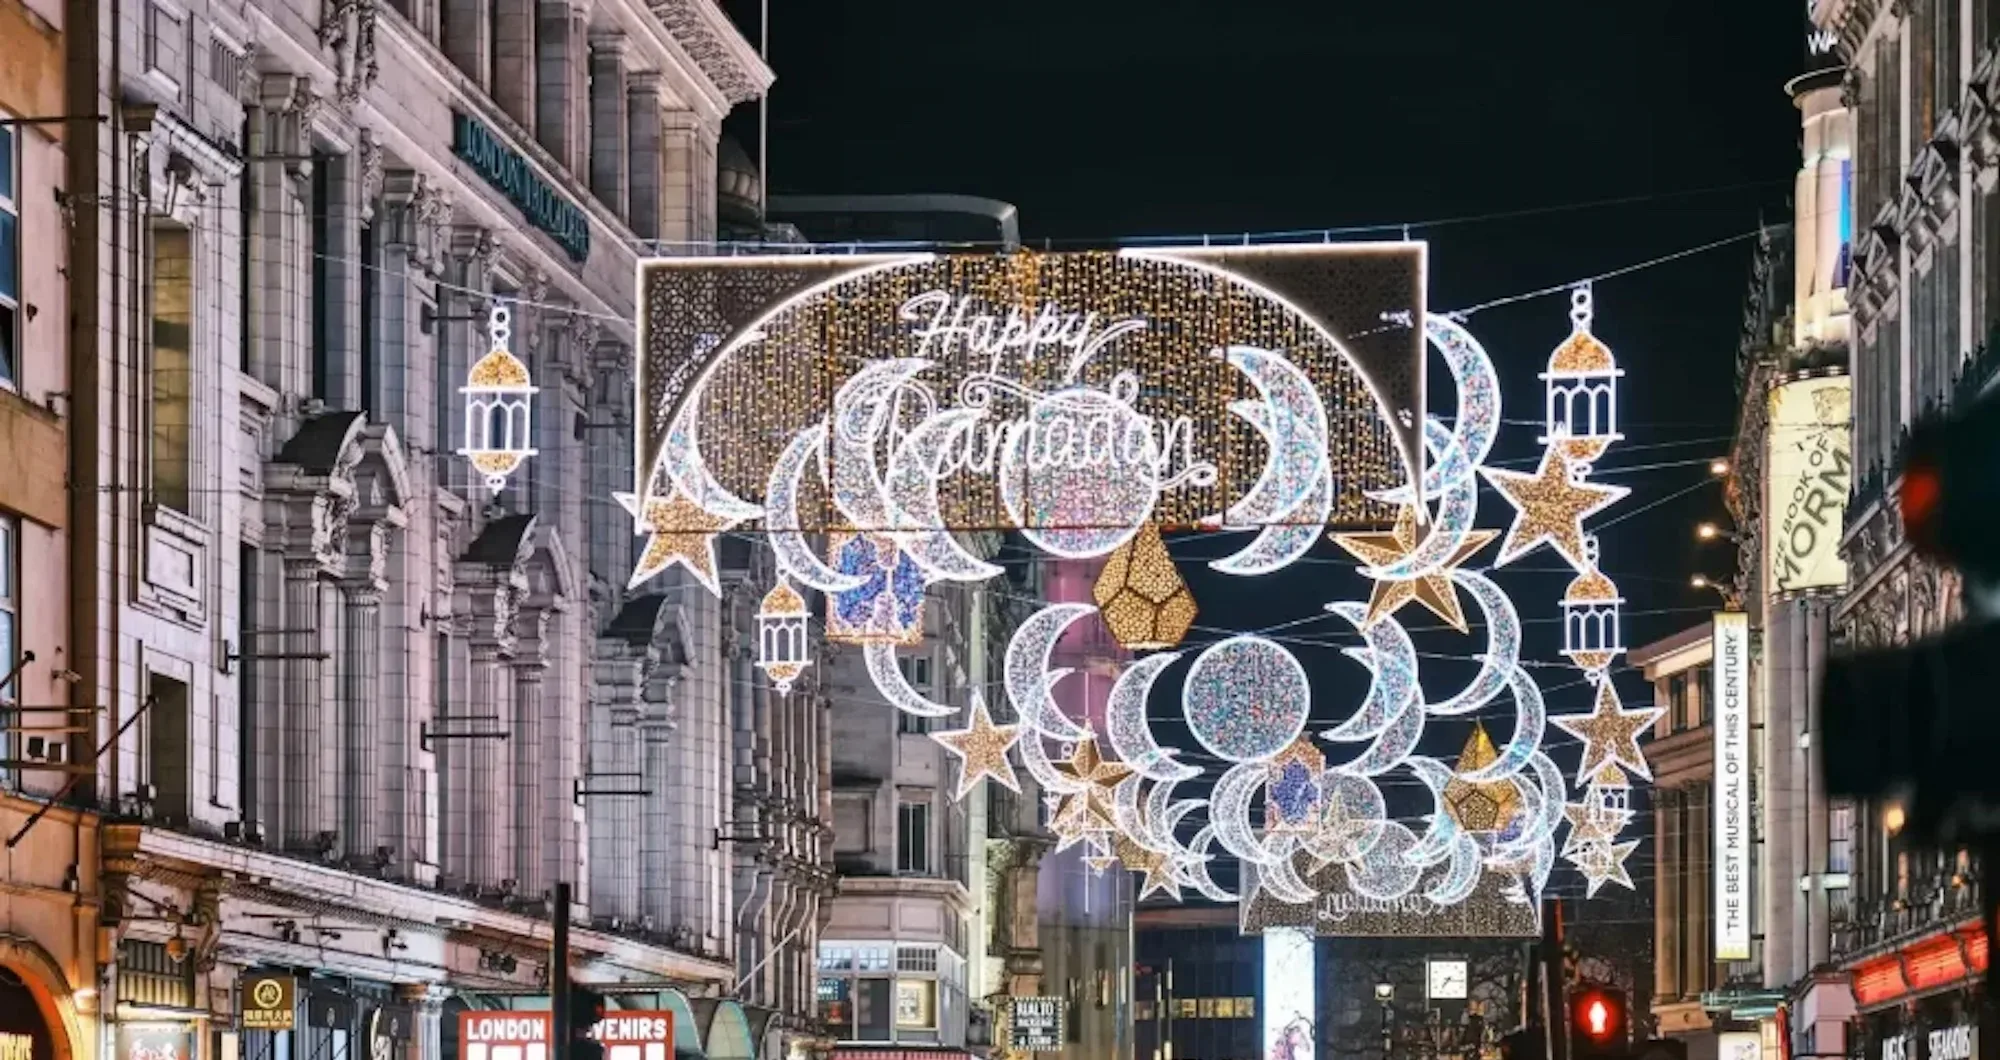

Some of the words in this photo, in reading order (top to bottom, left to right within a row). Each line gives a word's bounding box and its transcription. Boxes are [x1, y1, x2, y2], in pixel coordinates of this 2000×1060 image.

[902, 289, 1147, 383] Happy
[843, 372, 1217, 490] Ramadan
[1782, 469, 1814, 535] BOOK
[1809, 433, 1829, 467] OF
[1725, 713, 1739, 746] THIS
[1725, 752, 1739, 775] OF
[1726, 777, 1739, 849] MUSICAL
[1726, 854, 1739, 894] BEST
[467, 1018, 545, 1040] LONDON
[585, 1018, 667, 1040] VENIRS
